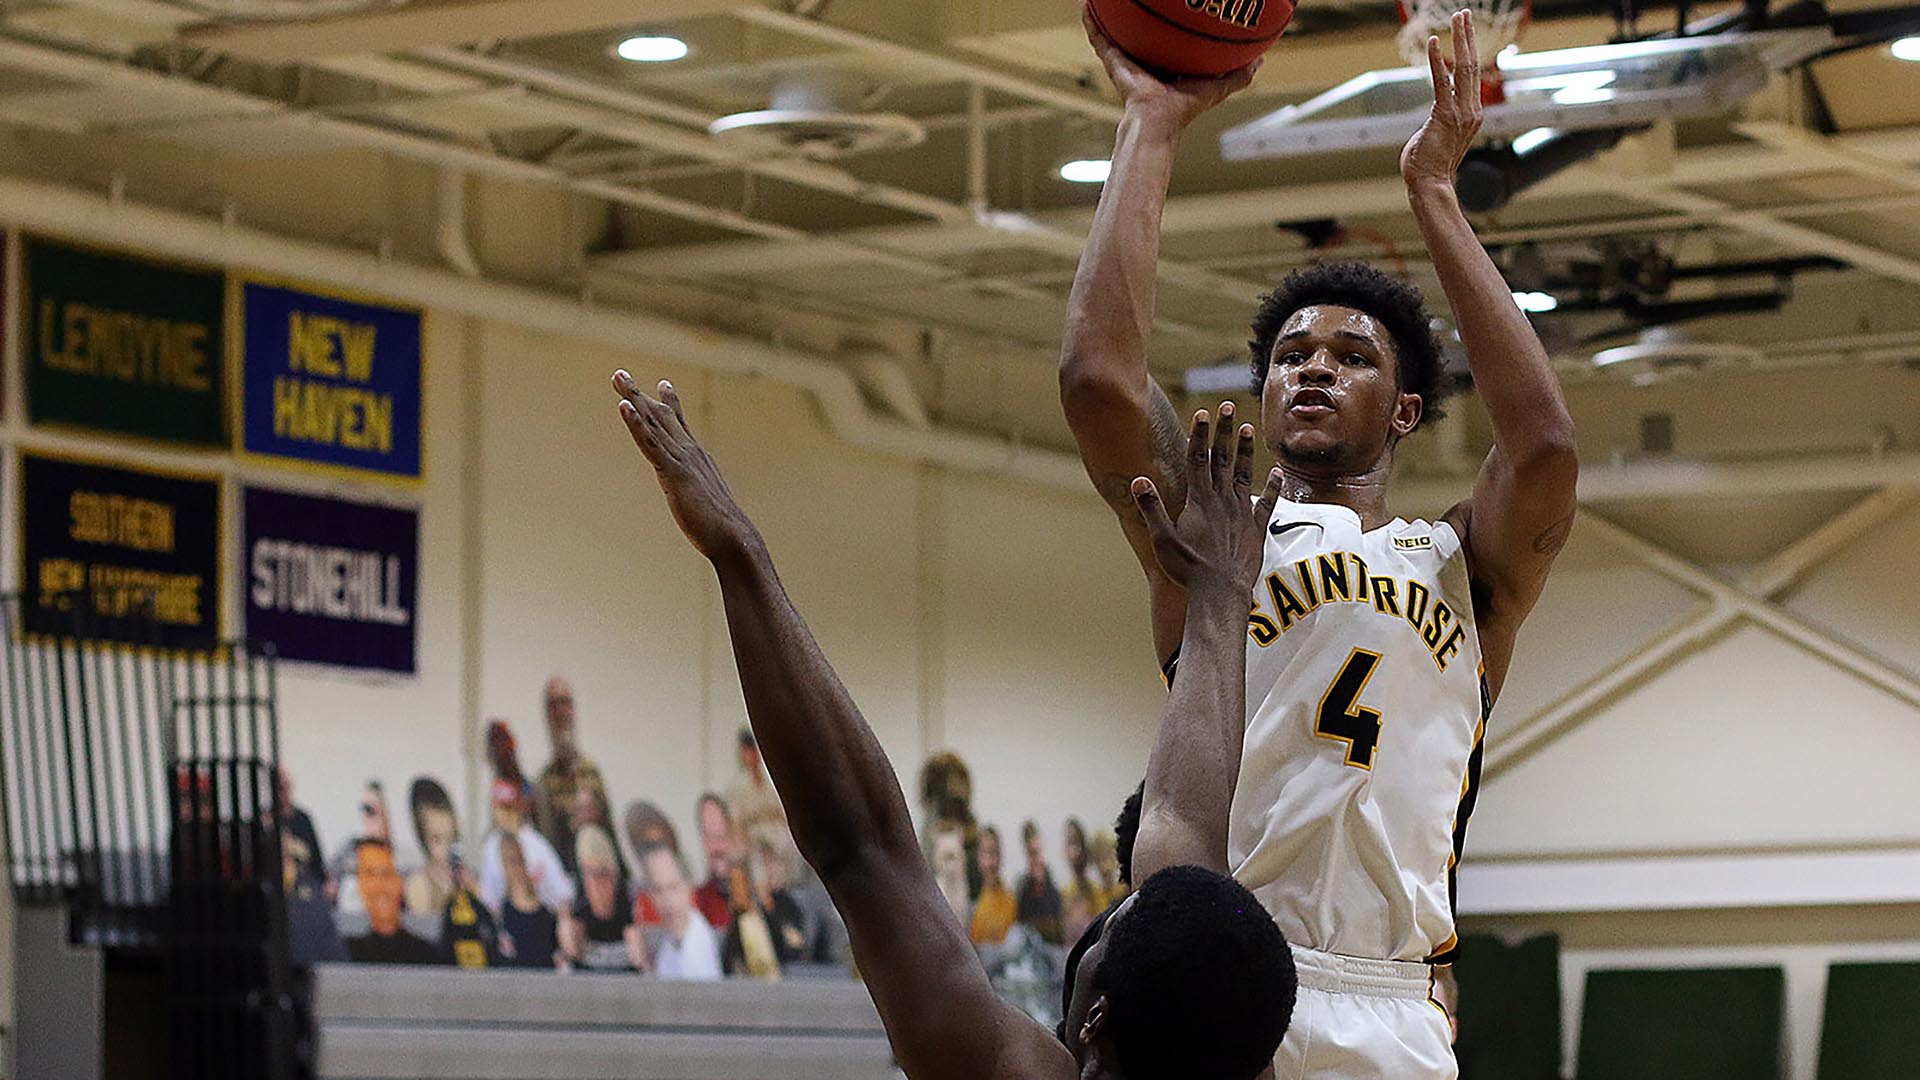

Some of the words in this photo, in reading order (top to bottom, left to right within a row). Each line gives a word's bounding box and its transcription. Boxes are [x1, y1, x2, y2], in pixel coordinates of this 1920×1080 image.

[288, 310, 376, 382] NEW
[273, 376, 393, 454] HAVEN
[251, 537, 409, 626] STONEHILL
[1369, 576, 1466, 673] ROSE
[1314, 646, 1384, 771] 4
